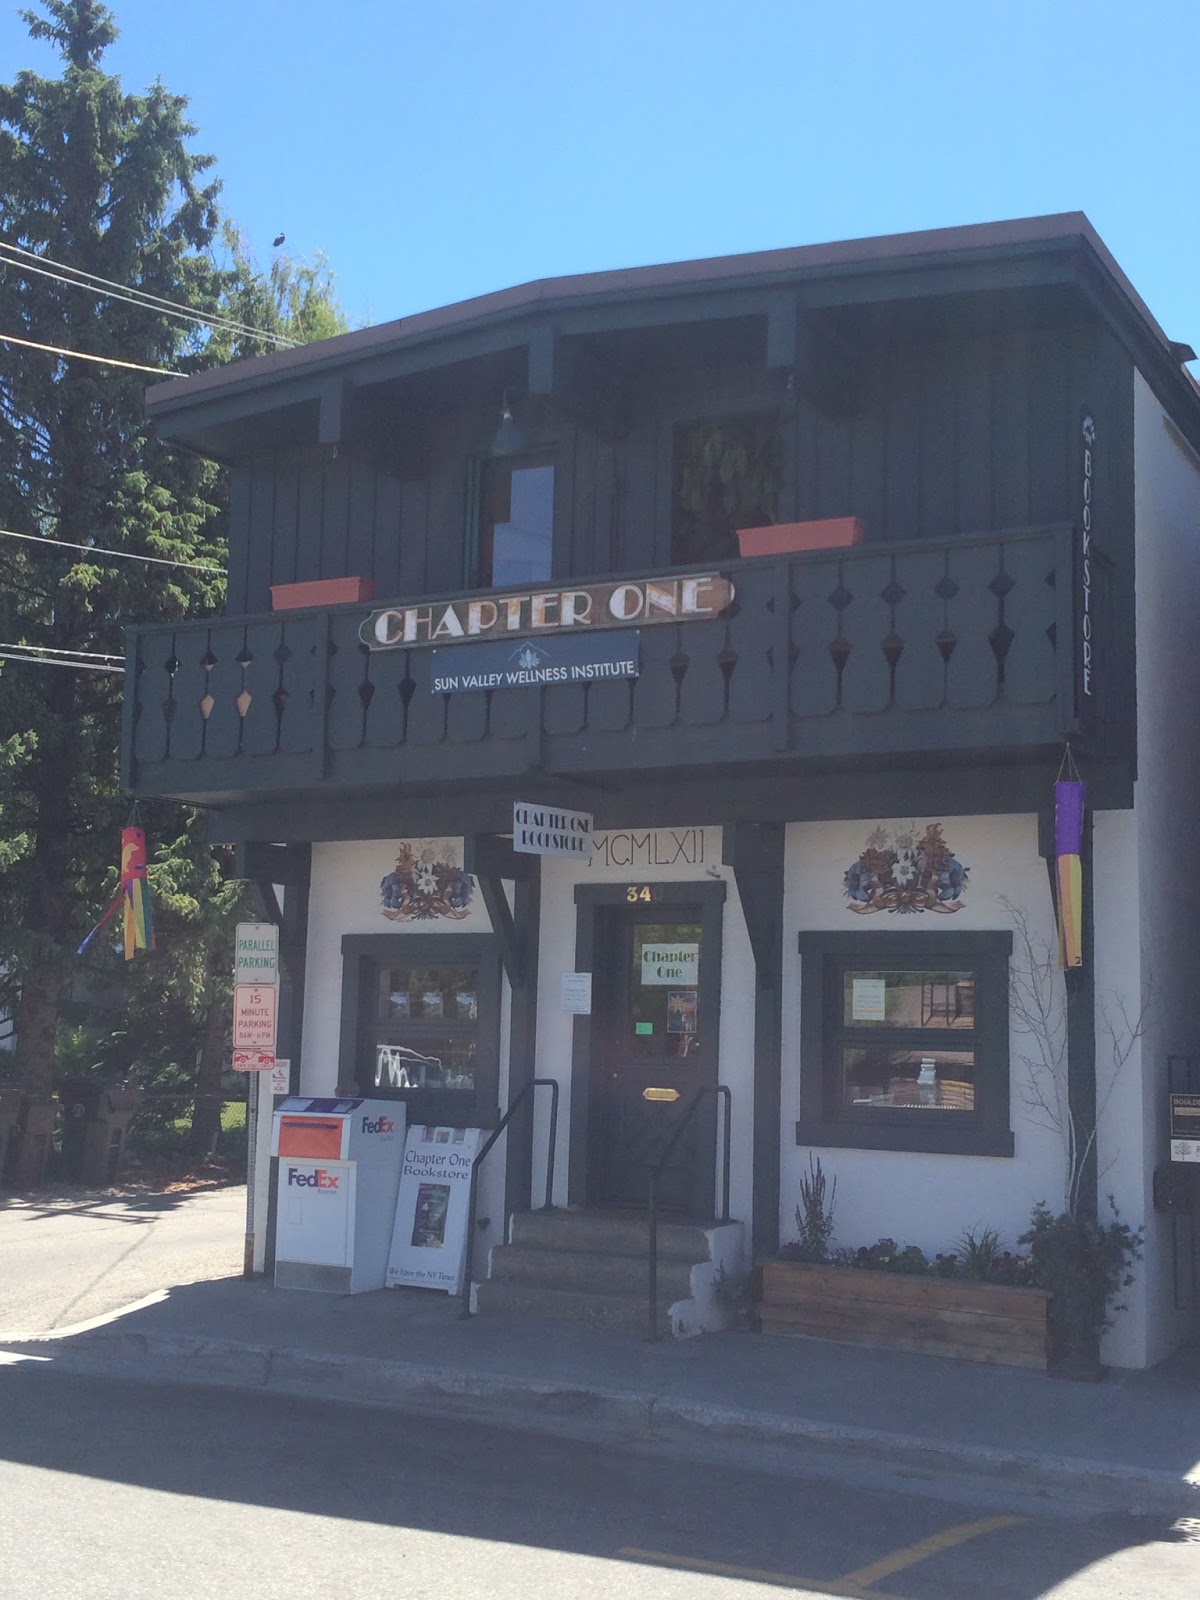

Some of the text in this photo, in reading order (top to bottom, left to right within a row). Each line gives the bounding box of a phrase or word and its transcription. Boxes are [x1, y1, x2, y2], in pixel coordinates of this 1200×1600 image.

[1082, 449, 1093, 696] BOOKSTORE
[374, 576, 714, 645] CHAPTER ONE
[433, 660, 636, 692] SUN VALLEY WELLNESS INSTITUTE
[515, 808, 592, 833] CHAPTER ONE
[521, 830, 586, 852] BOOKSTORE
[627, 887, 652, 902] 34
[239, 939, 275, 952] PARALLEL
[238, 956, 275, 969] PARKING
[643, 951, 697, 964] Chapter
[656, 967, 683, 979] One
[250, 995, 262, 1004] 15
[241, 1008, 270, 1017] MINUTE
[238, 1020, 272, 1029] PARKING
[362, 1116, 394, 1134] FedEx
[404, 1150, 471, 1167] Chapter One
[288, 1168, 340, 1189] FedEx
[403, 1165, 469, 1179] Bookstore
[388, 1266, 400, 1276] We
[415, 1270, 426, 1278] the
[427, 1271, 438, 1280] NY
